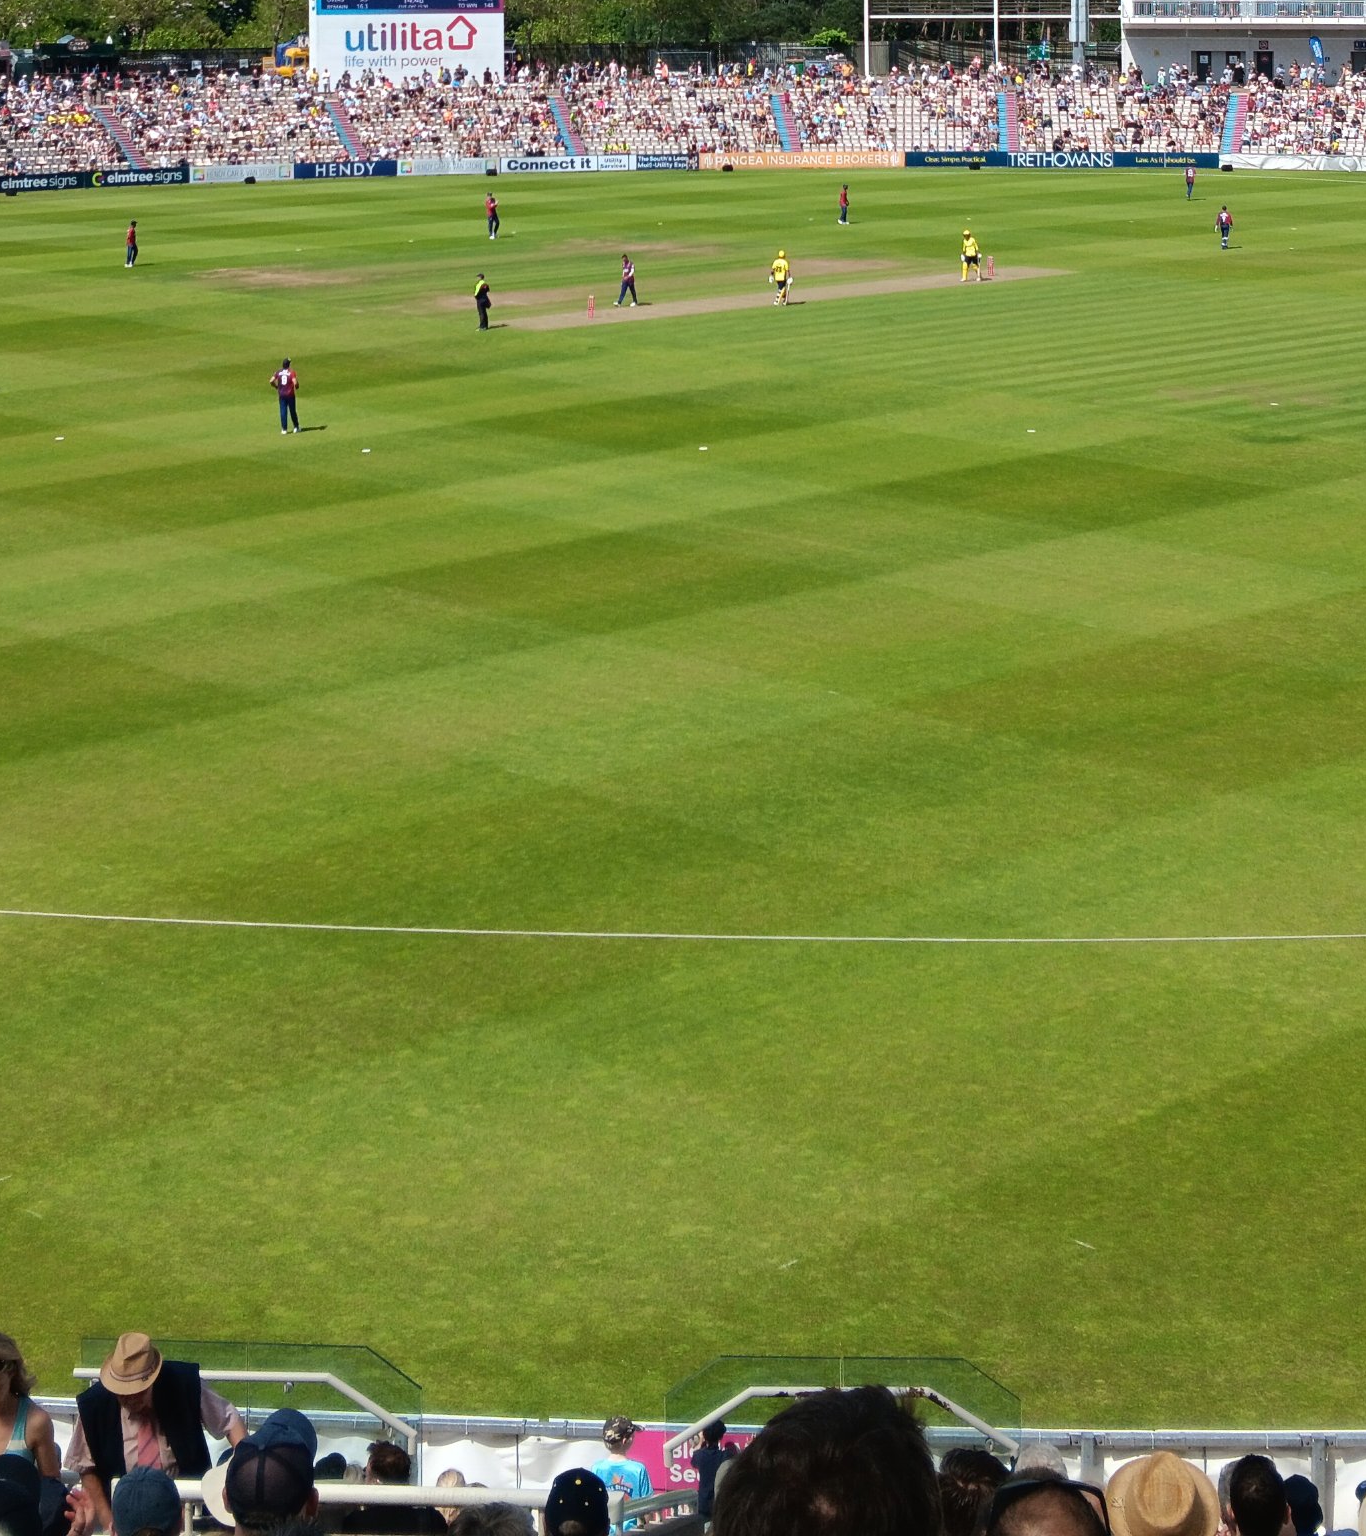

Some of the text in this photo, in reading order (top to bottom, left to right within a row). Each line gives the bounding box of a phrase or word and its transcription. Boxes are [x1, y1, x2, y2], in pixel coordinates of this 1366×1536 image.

[345, 22, 442, 51] utilita
[344, 56, 443, 69] life with power
[507, 158, 591, 170] Connect it
[715, 154, 889, 166] PANGEA INSURANCE BROKERS
[1008, 153, 1113, 168] TRETHOWANS
[1164, 156, 1186, 164] should
[107, 169, 182, 184] elmtree signs
[315, 163, 376, 177] HENDY
[1, 175, 78, 189] elmtree signs
